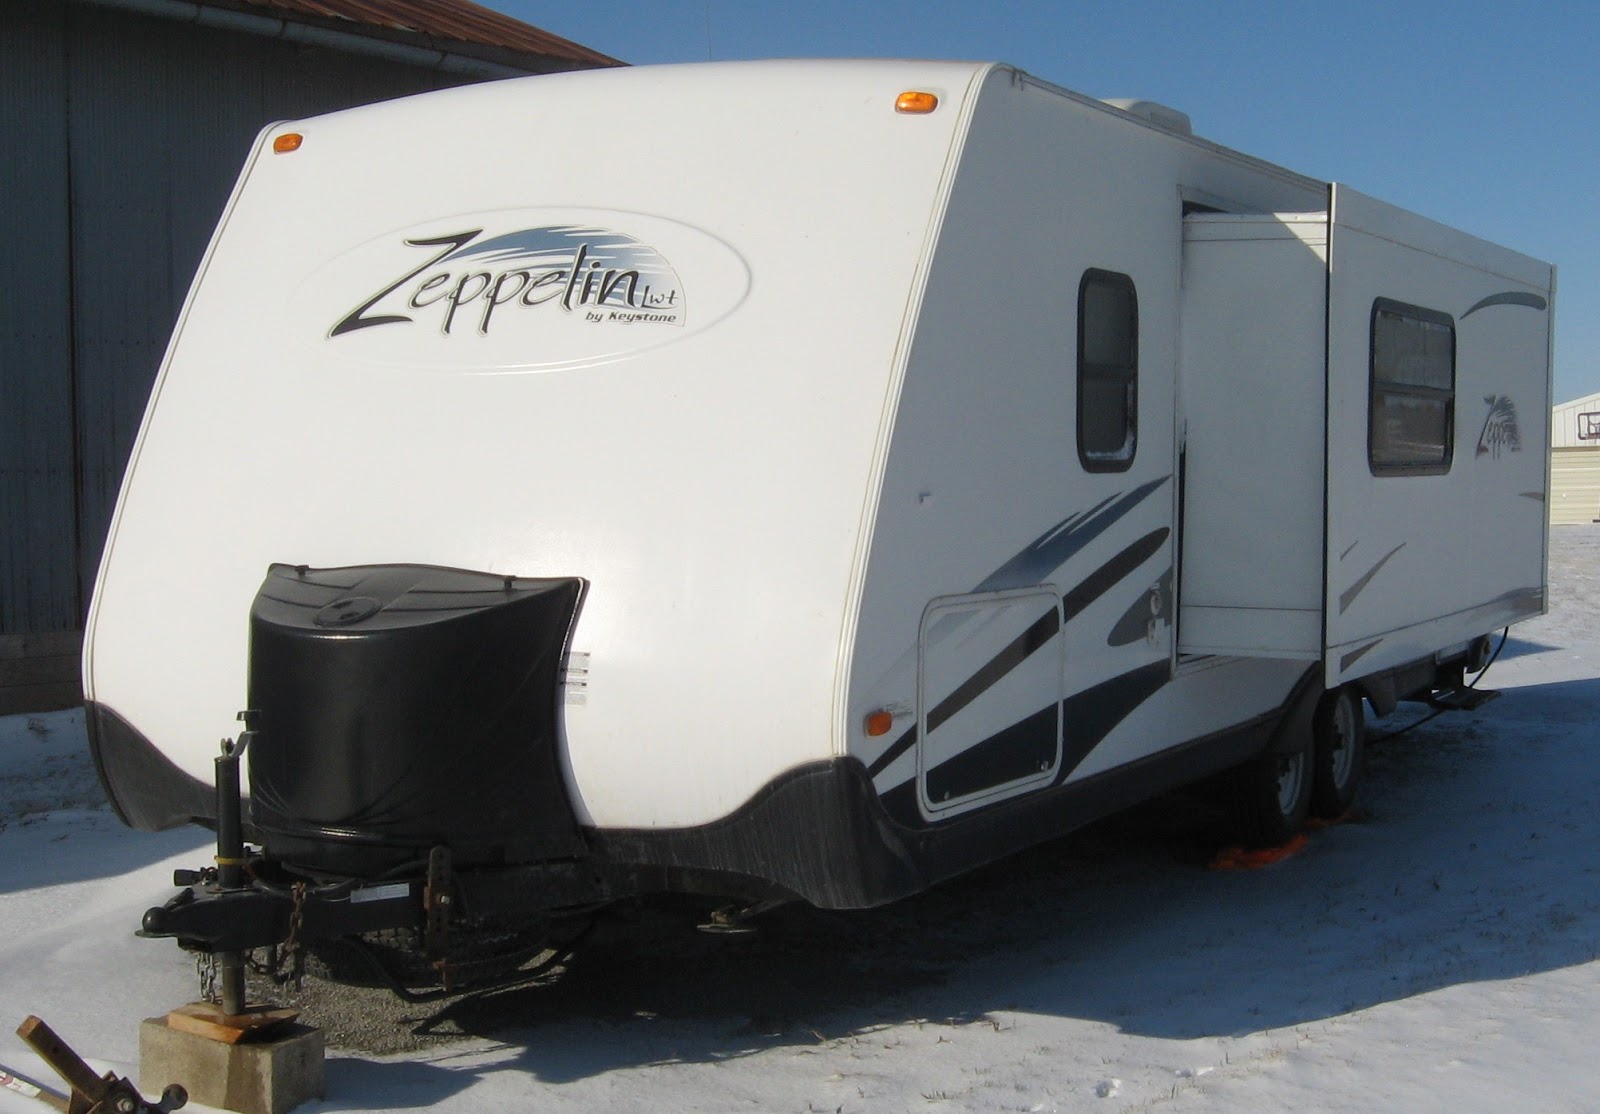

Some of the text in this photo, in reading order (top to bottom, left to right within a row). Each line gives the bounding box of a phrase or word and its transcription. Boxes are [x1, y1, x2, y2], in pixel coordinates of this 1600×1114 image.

[326, 227, 640, 338] Zeppelin
[585, 310, 677, 324] by Keystone
